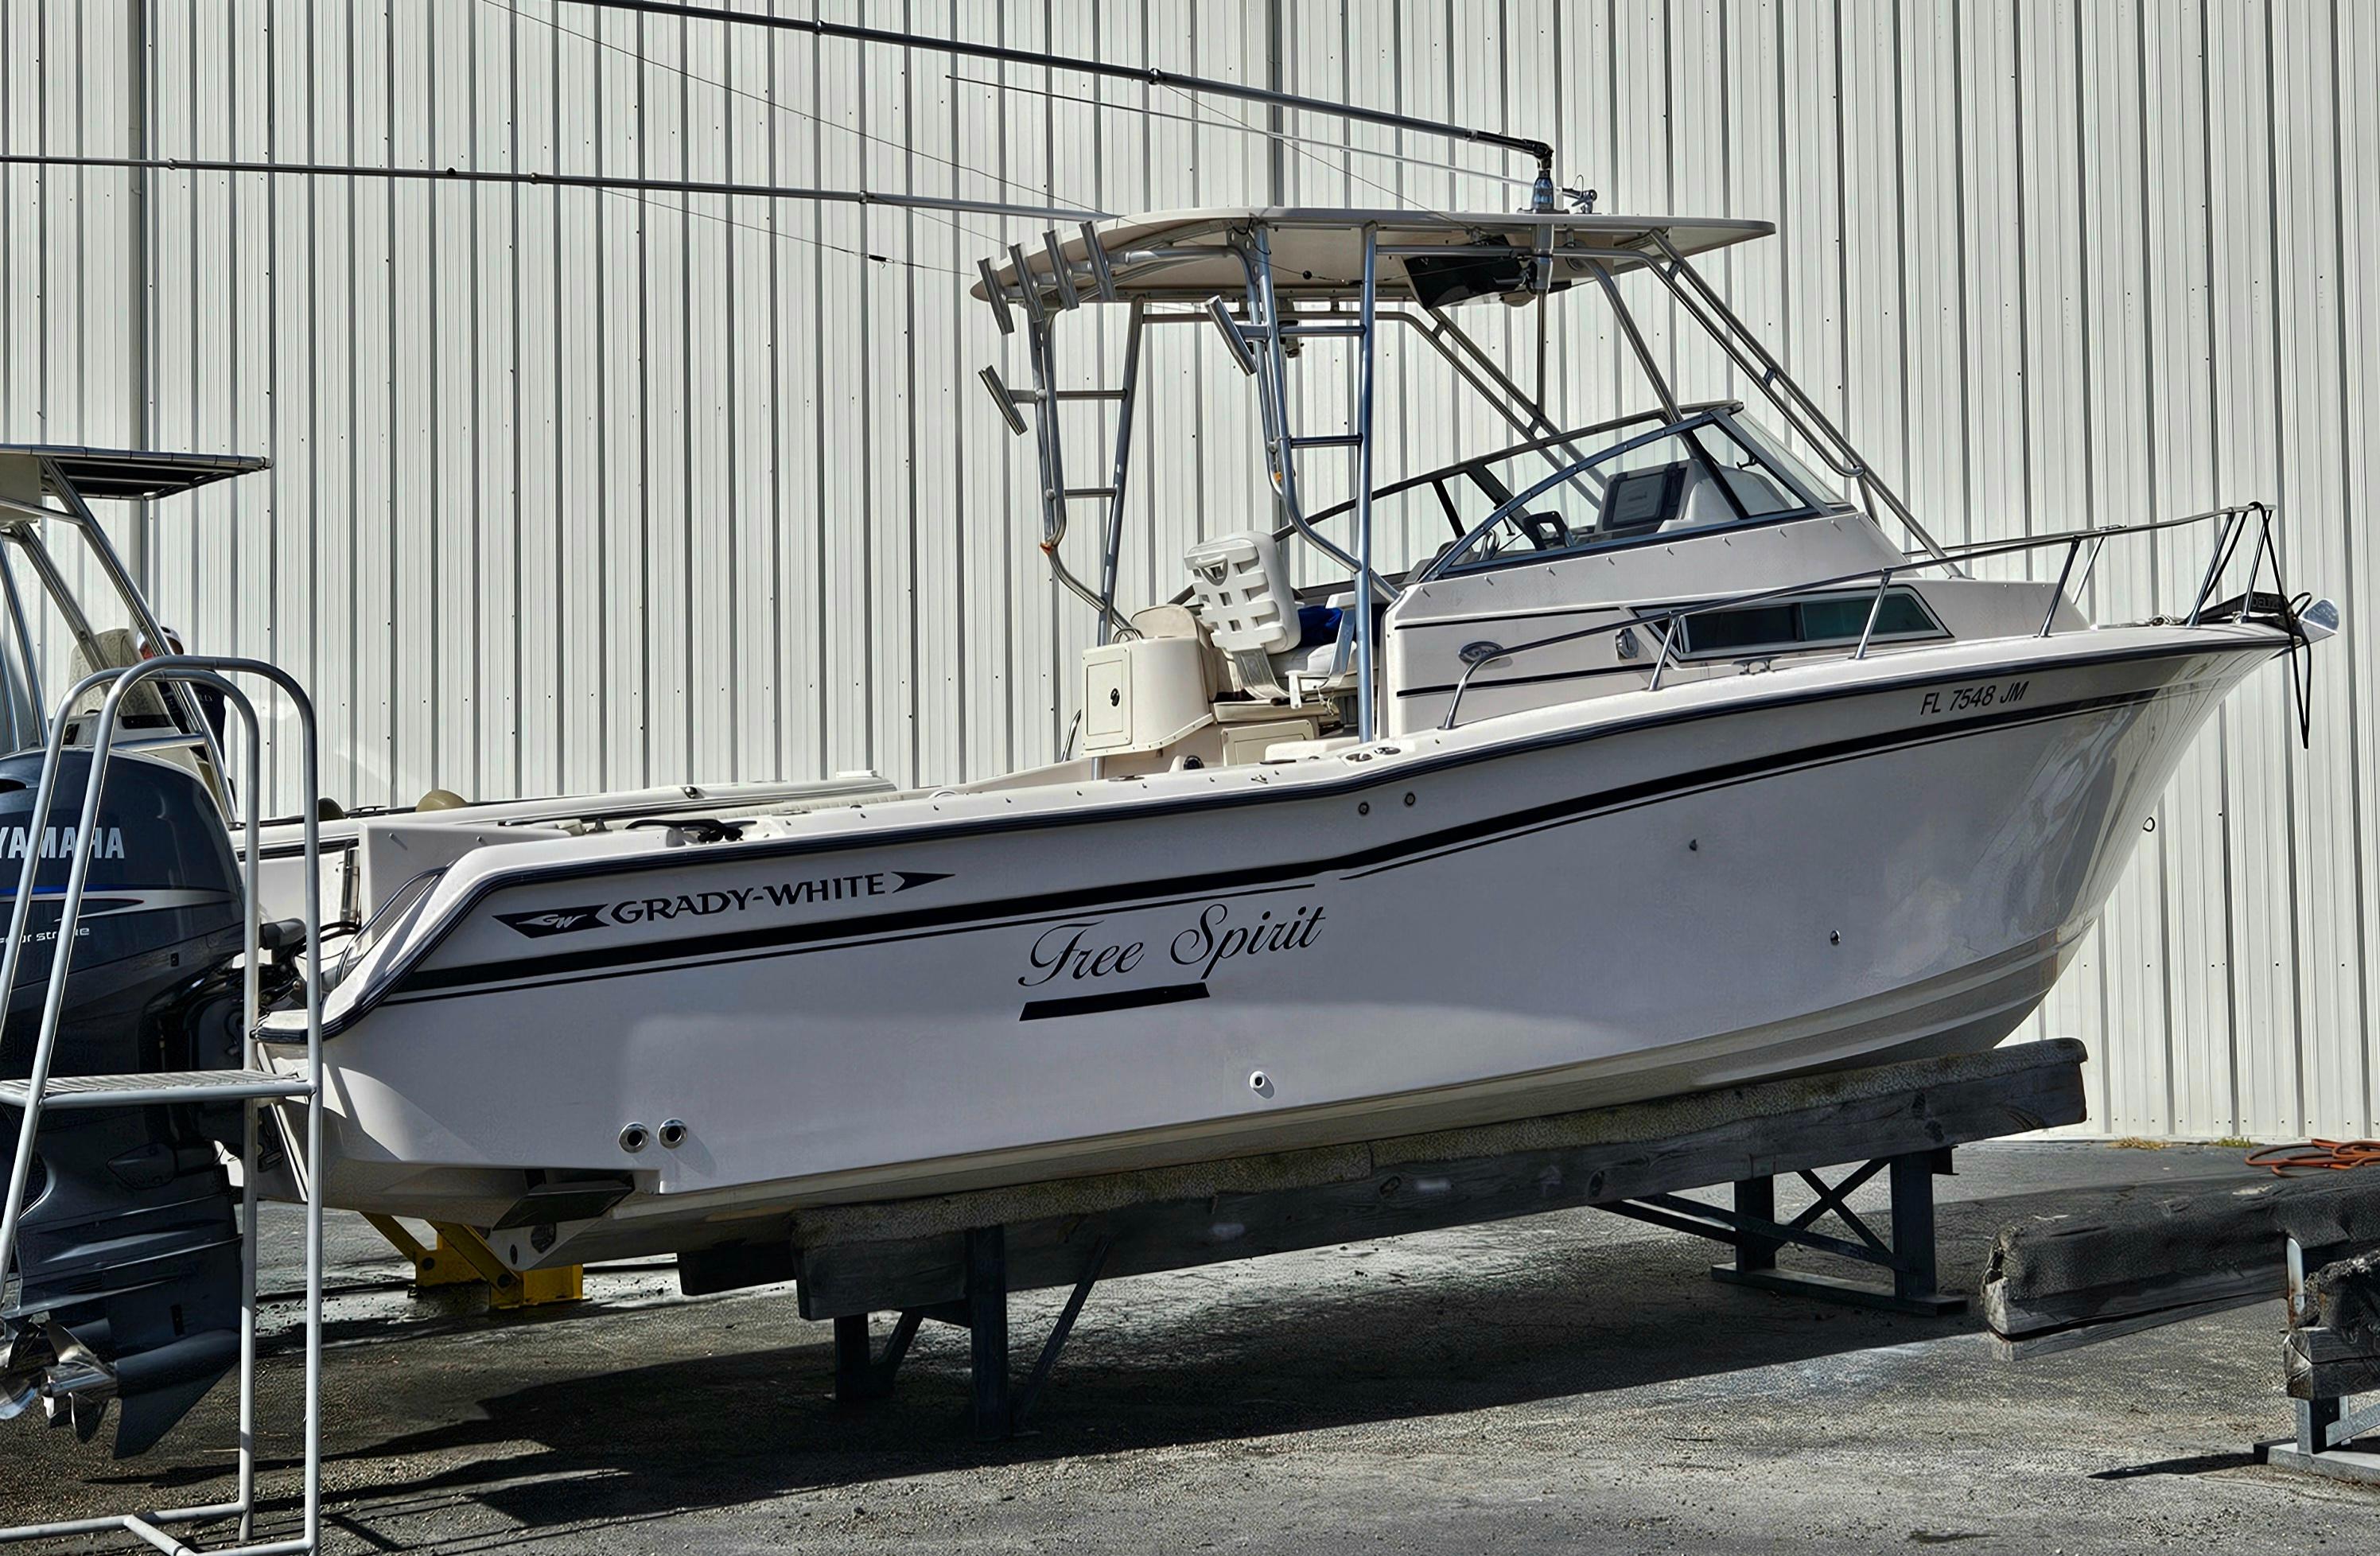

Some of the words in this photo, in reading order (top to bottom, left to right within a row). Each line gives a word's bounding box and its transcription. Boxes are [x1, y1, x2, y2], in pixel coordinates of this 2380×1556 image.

[1920, 691, 1941, 715] FL
[1949, 685, 1997, 711] 7548
[2000, 681, 2029, 704] JM
[610, 873, 885, 924] GRADY-WHITE
[36, 928, 90, 942] stre
[1017, 920, 1144, 987] Free
[1169, 904, 1326, 980] Spirit
